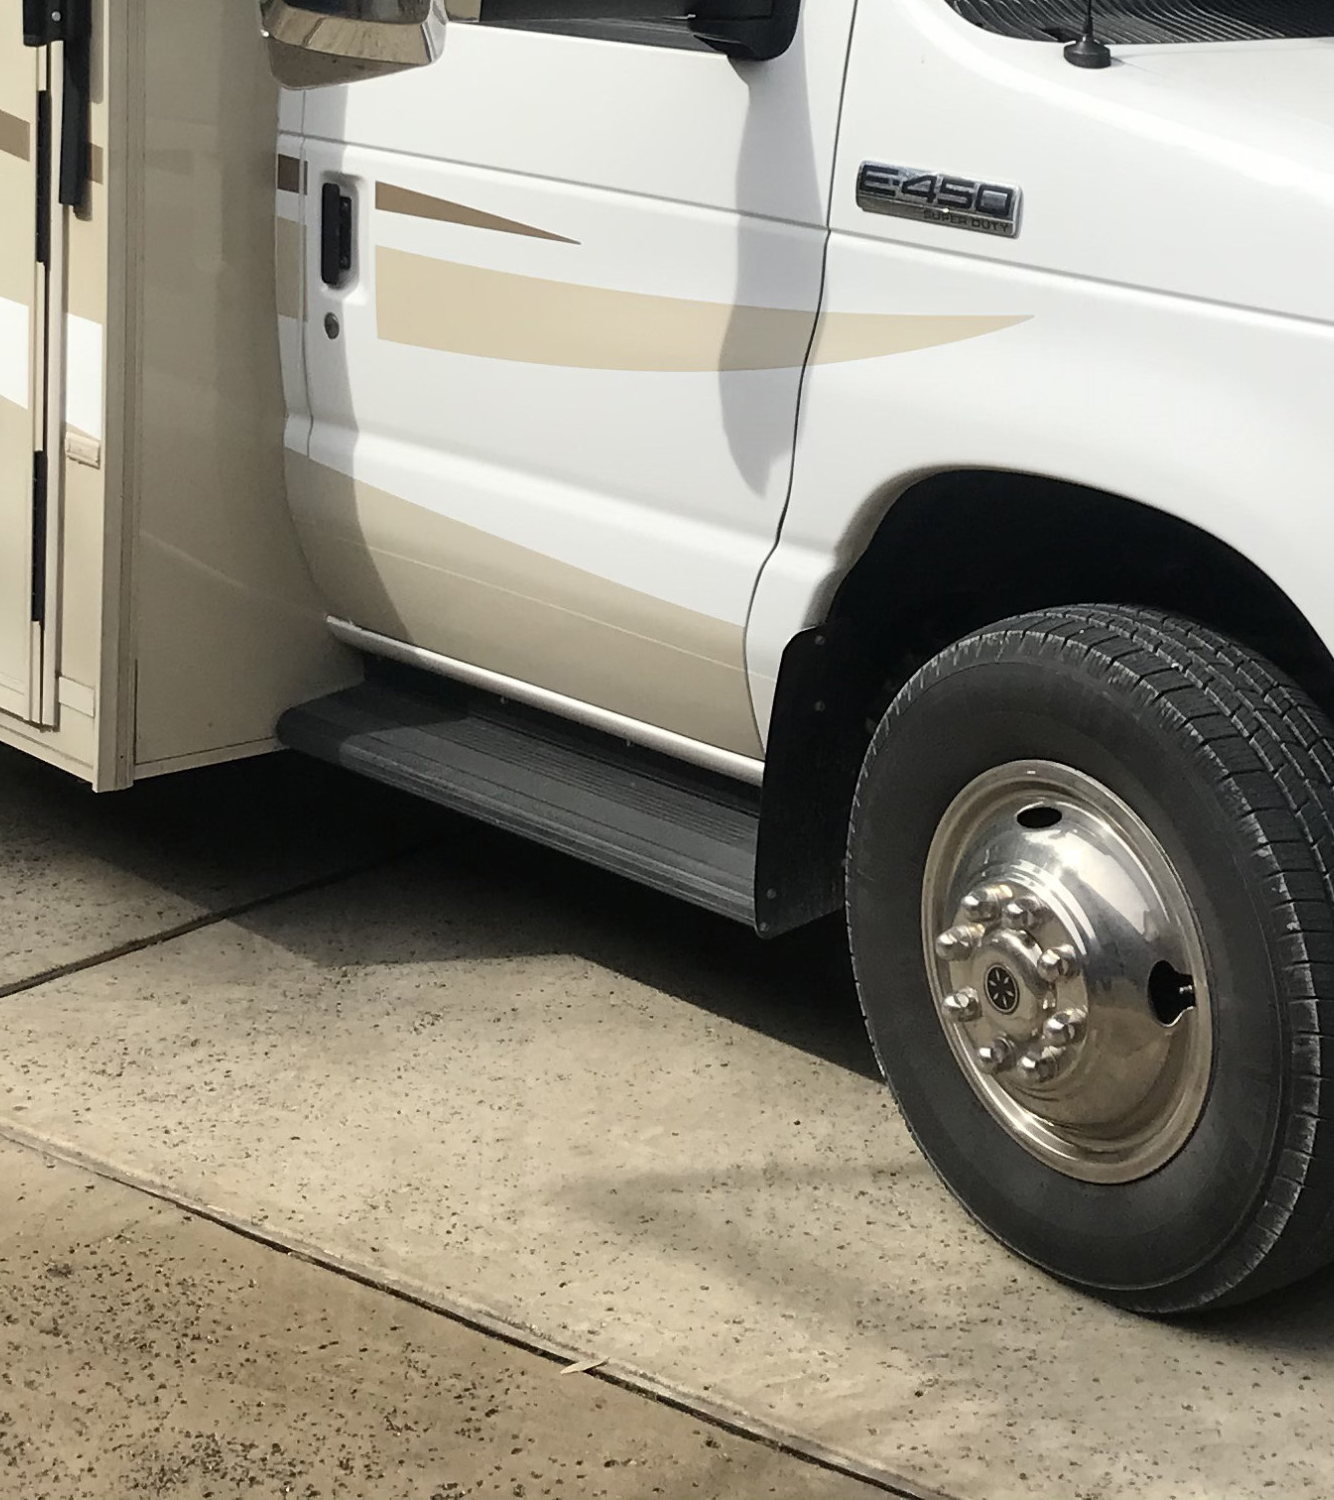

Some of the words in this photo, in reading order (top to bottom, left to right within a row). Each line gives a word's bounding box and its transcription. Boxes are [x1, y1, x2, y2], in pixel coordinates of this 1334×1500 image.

[859, 164, 1015, 218] E-450
[923, 209, 967, 227] SUPER
[971, 218, 1010, 233] DUTY
